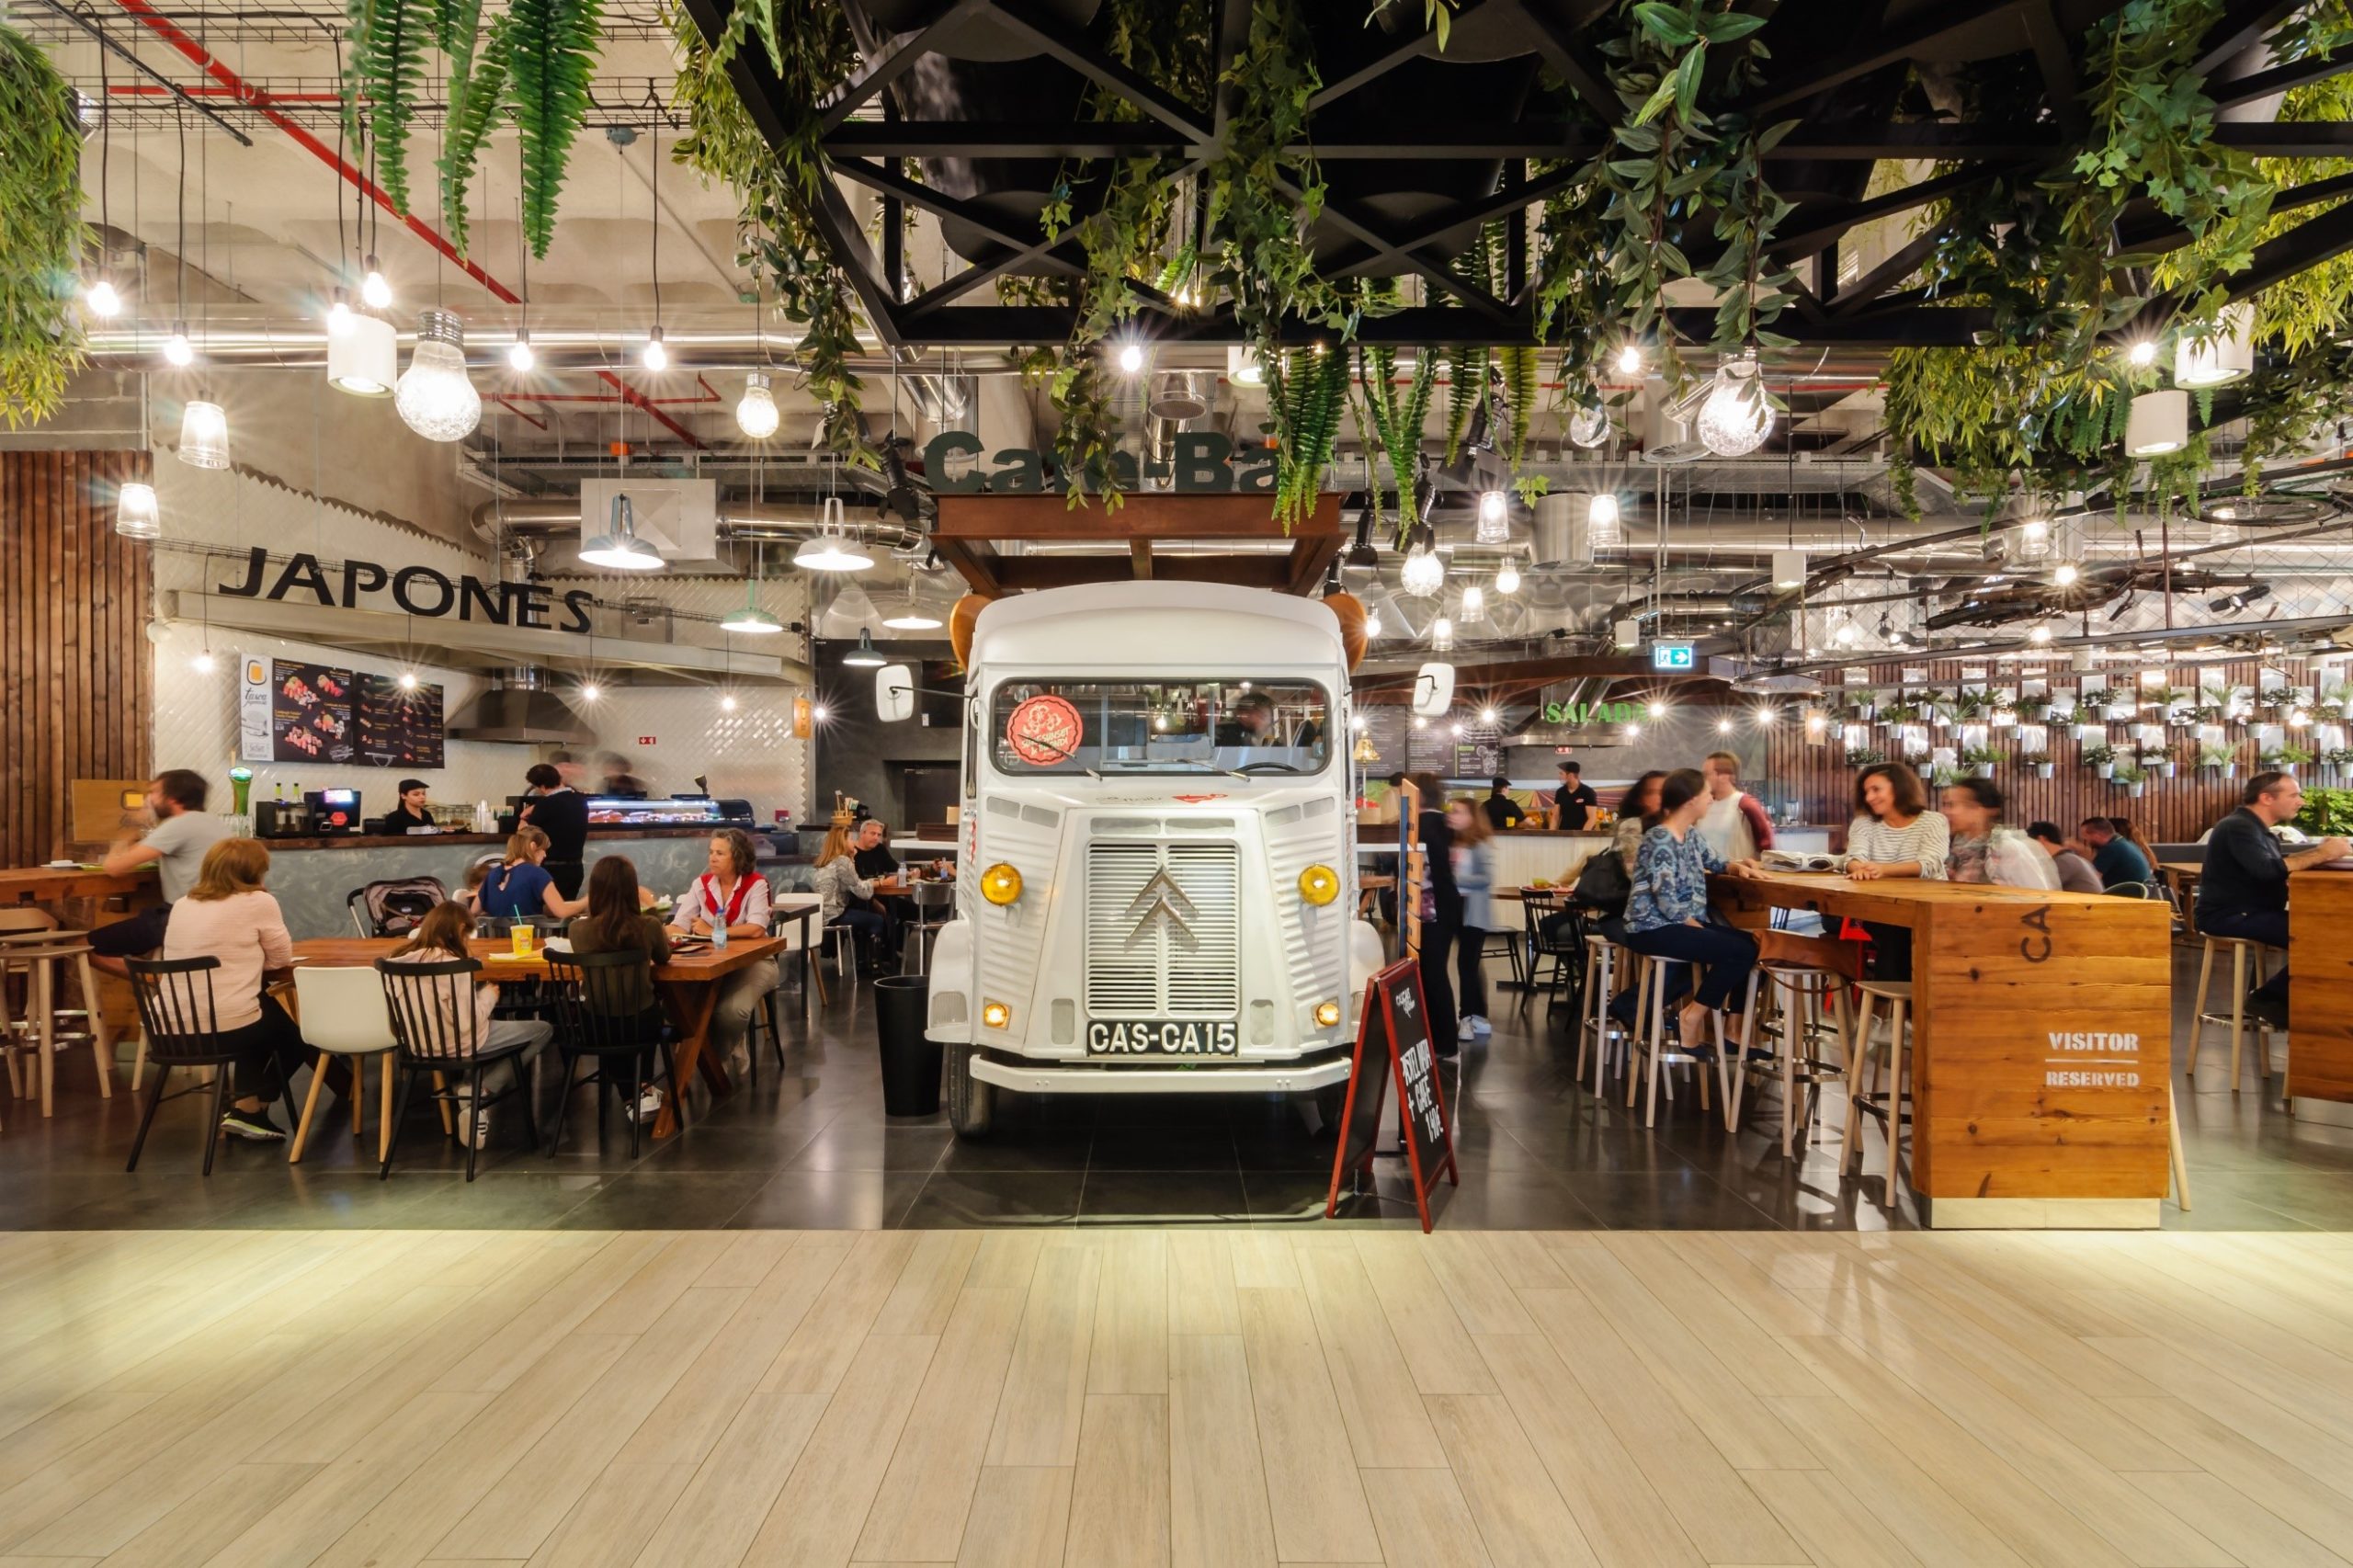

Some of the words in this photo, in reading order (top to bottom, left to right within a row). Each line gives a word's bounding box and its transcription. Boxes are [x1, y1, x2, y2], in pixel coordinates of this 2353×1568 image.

[218, 546, 594, 634] JAPONÊS
[2048, 1032, 2140, 1051] VISITOR
[2046, 1071, 2140, 1087] RESERVED
